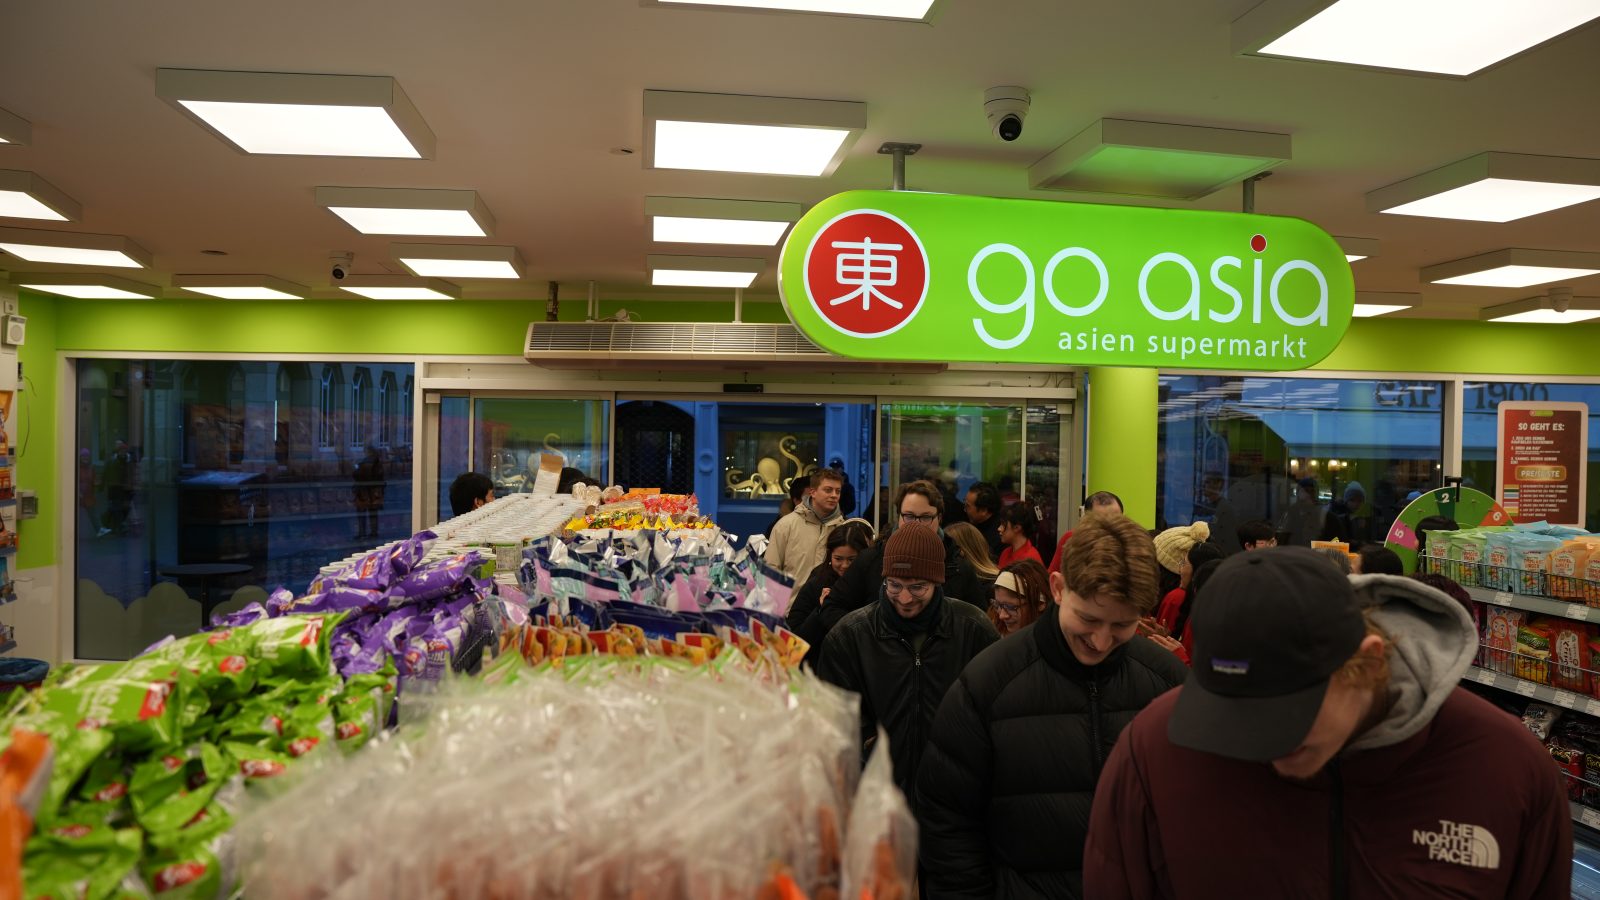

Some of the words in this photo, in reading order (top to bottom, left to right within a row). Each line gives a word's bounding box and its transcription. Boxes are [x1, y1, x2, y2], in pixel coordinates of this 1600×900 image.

[830, 236, 904, 312] 東
[967, 242, 1110, 350] go
[1137, 233, 1329, 328] asia
[1058, 328, 1135, 353] asien
[1147, 331, 1308, 360] supermarkt
[1375, 381, 1442, 409] CAF
[1518, 422, 1529, 431] SO
[1530, 422, 1551, 431] GEHT
[1552, 422, 1565, 431] ES:
[1441, 493, 1450, 503] 2
[1492, 511, 1503, 521] 6
[1394, 528, 1404, 539] 5
[1439, 819, 1473, 838] THE
[1412, 829, 1472, 852] NORTH
[1429, 846, 1473, 866] FACE
